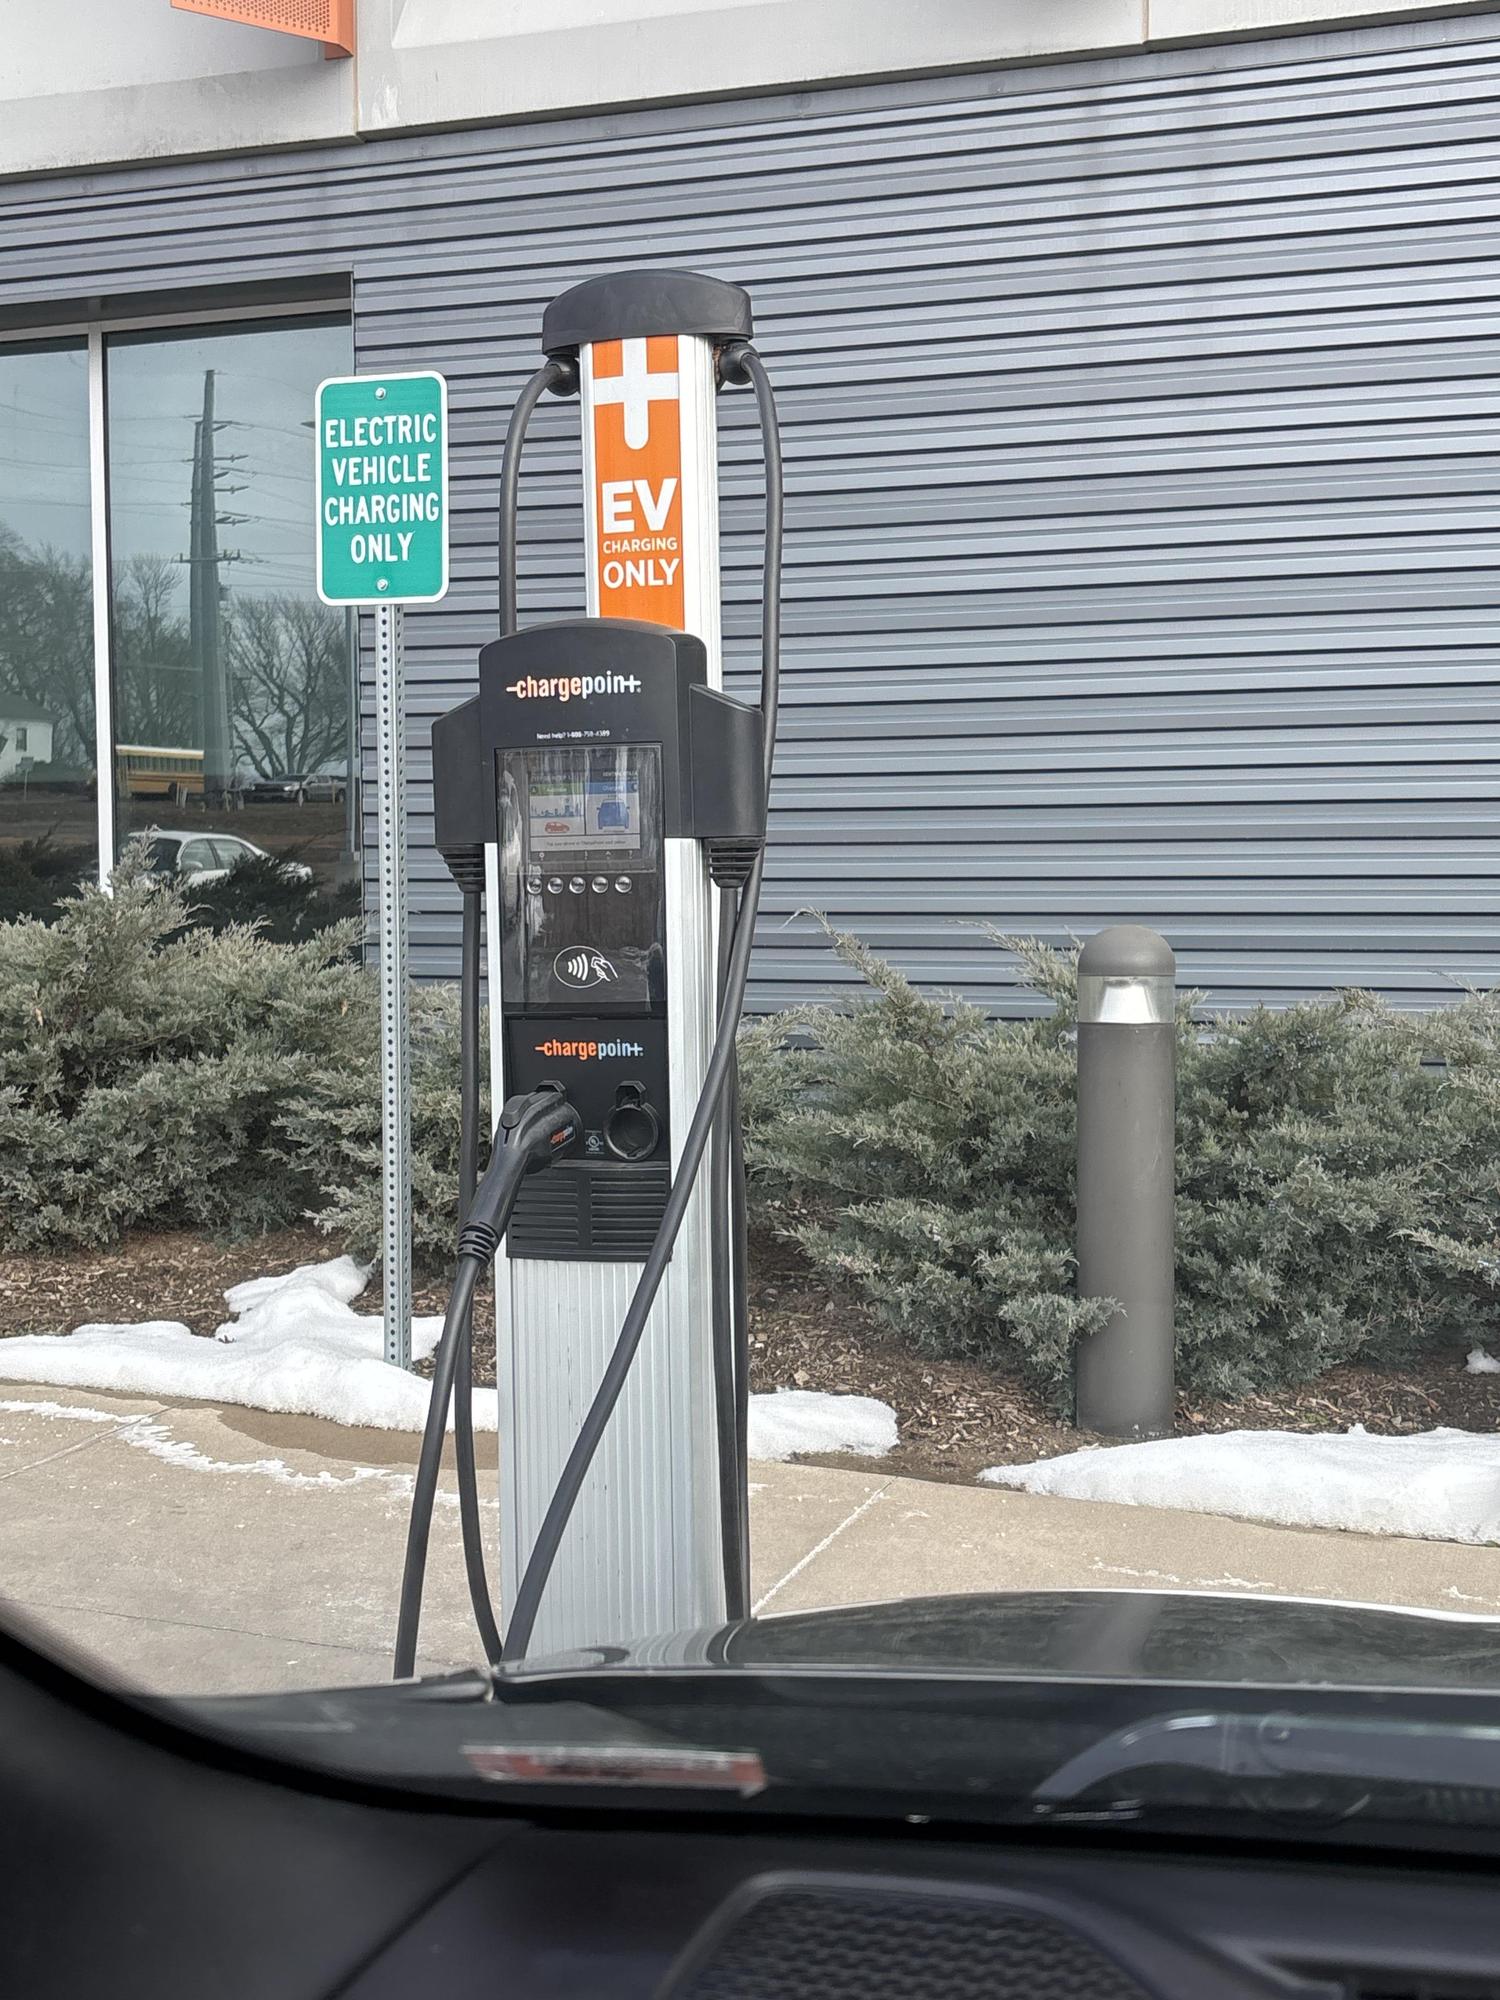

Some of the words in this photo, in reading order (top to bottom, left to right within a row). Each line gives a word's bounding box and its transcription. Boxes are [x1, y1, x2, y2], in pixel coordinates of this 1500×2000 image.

[325, 413, 437, 449] ELECTRIC
[331, 453, 432, 486] VEHICLE
[324, 492, 439, 526] CHARGING
[602, 477, 678, 534] EV
[350, 532, 415, 564] ONLY
[603, 537, 678, 555] CHARGING
[603, 558, 680, 589] ONLY
